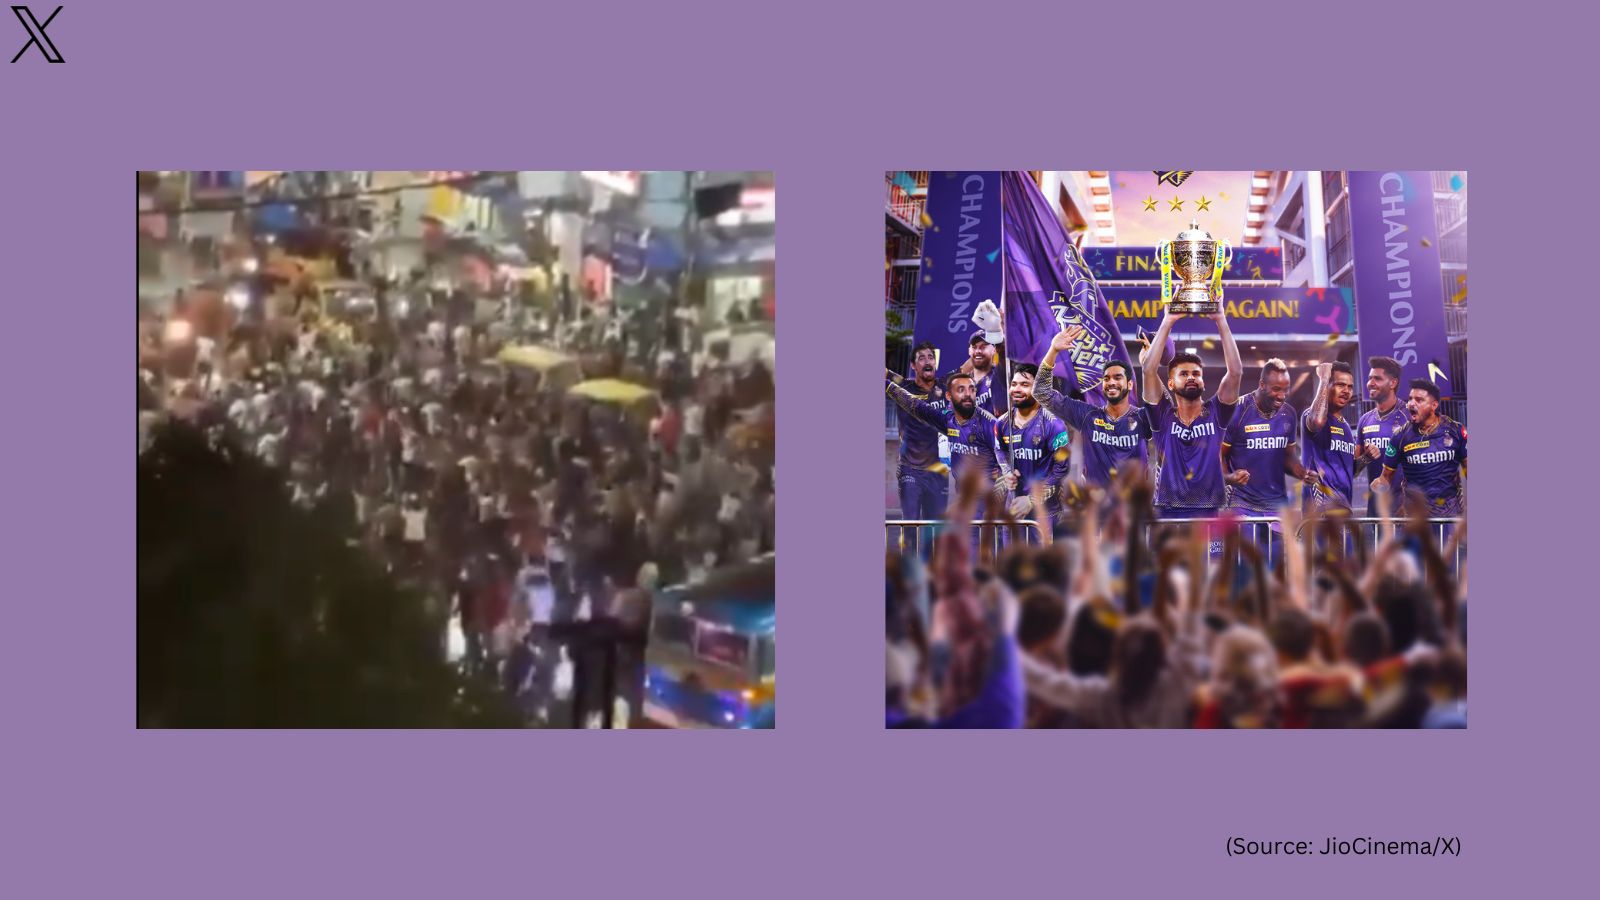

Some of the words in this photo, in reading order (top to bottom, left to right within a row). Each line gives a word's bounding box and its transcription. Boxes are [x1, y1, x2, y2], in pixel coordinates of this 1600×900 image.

[948, 174, 985, 333] CHAMPIONS
[1115, 255, 1163, 271] FINA
[1379, 172, 1418, 368] CHAMPIONS
[1225, 299, 1299, 319] AGAIN!
